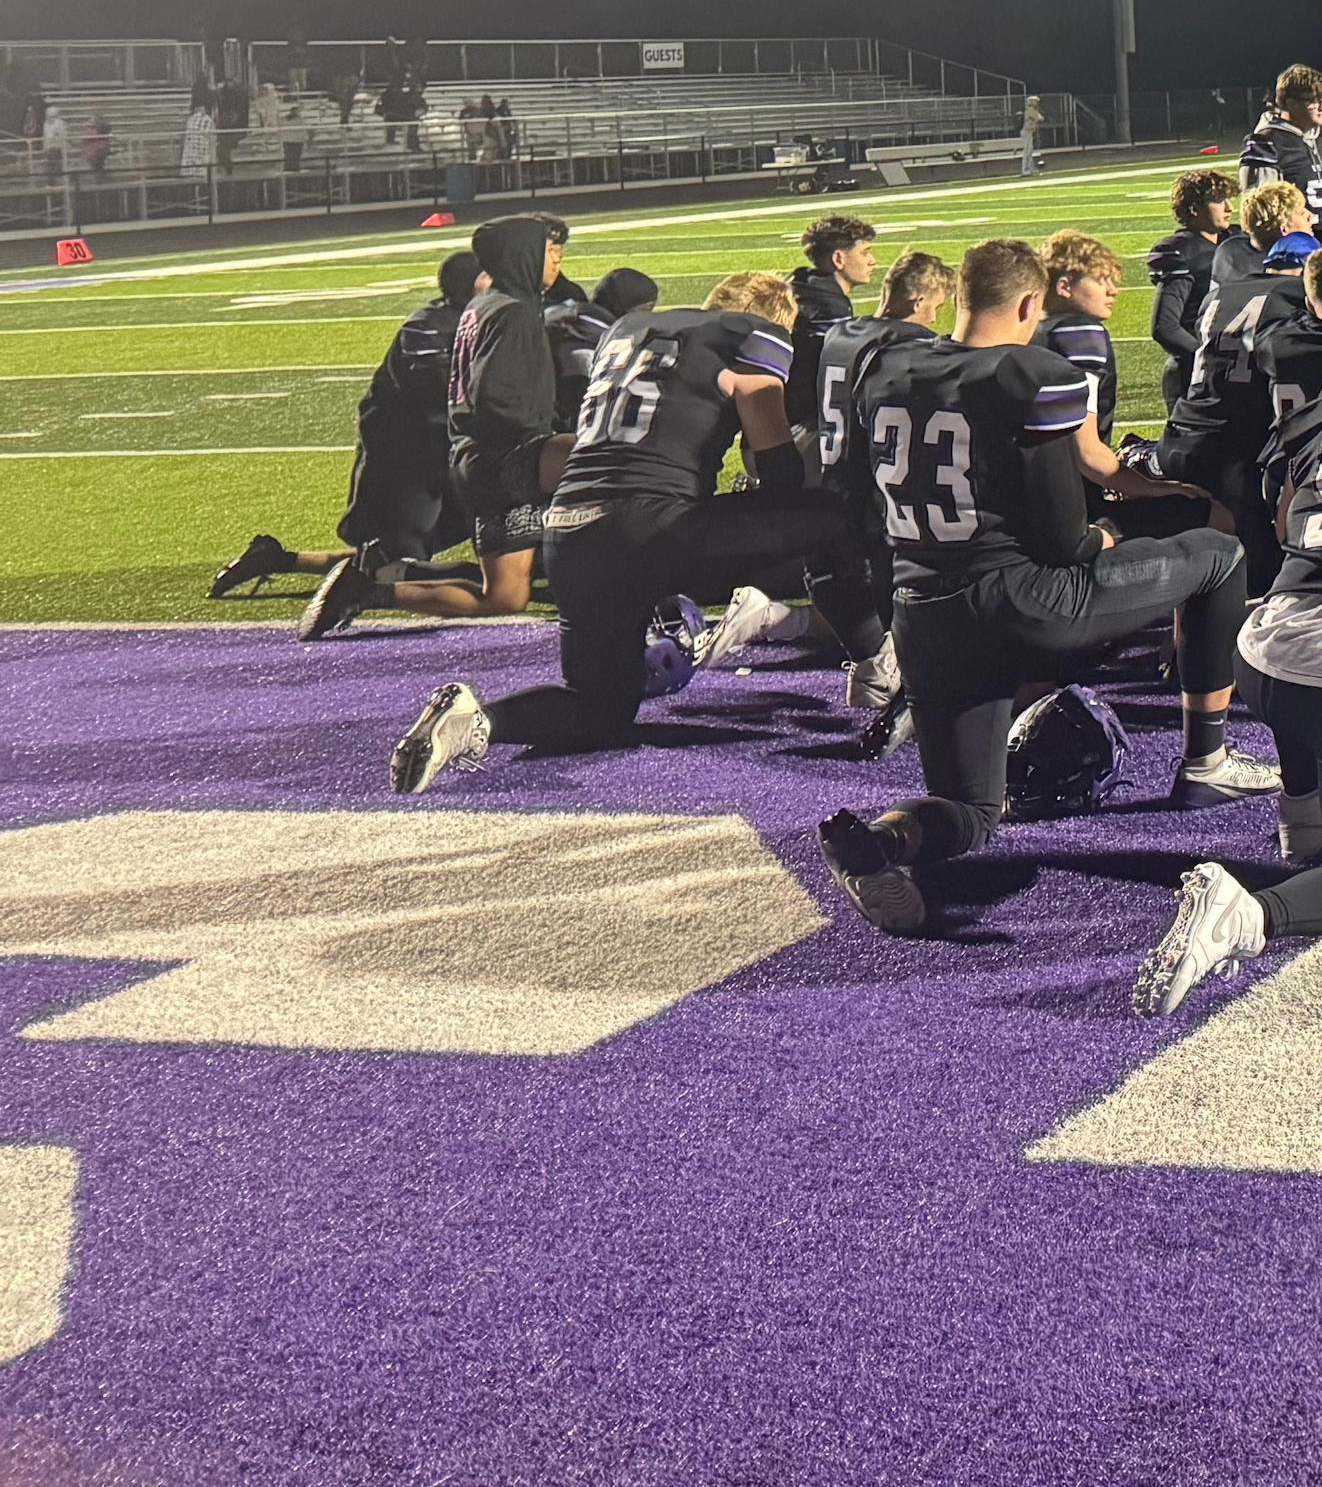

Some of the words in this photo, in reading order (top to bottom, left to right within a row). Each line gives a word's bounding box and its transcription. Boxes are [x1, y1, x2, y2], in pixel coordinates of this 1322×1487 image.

[644, 48, 683, 62] GUESTS
[65, 242, 87, 259] 30
[1191, 295, 1269, 386] 14
[873, 406, 979, 542] 23
